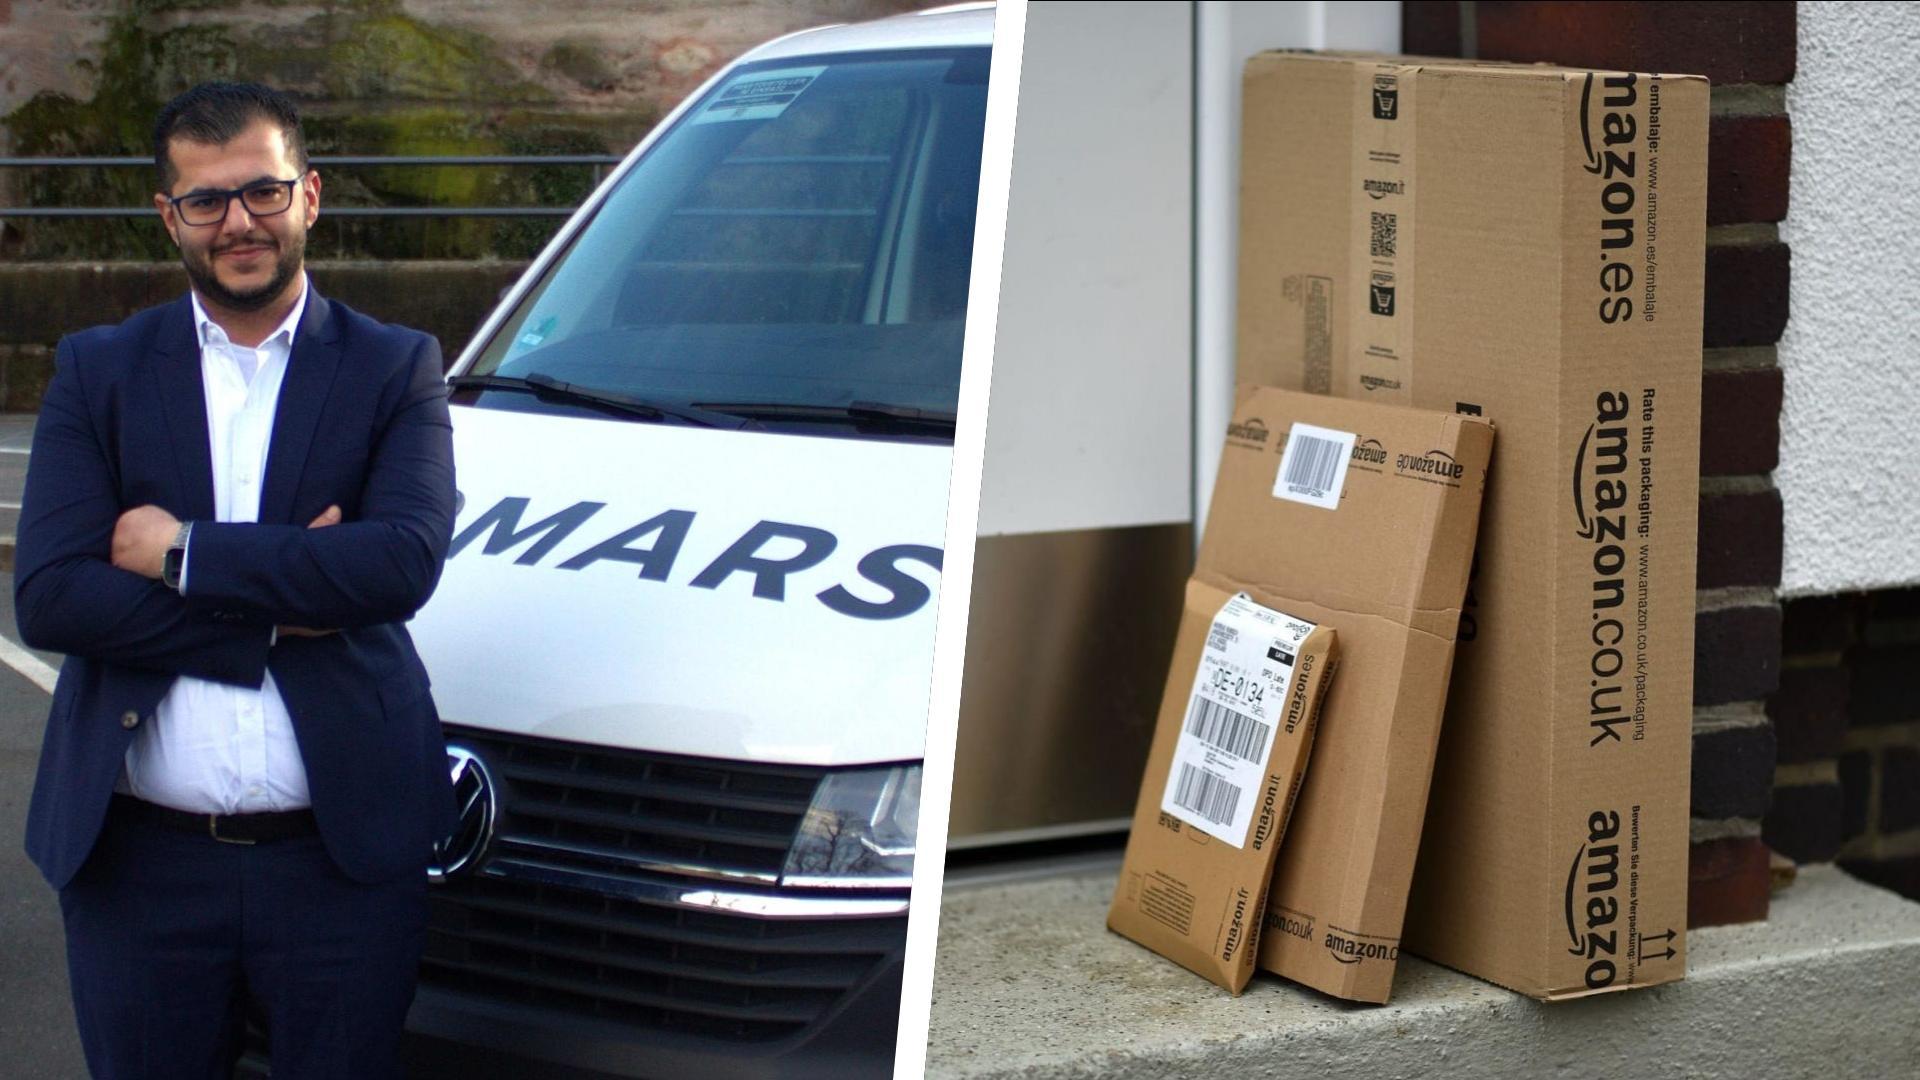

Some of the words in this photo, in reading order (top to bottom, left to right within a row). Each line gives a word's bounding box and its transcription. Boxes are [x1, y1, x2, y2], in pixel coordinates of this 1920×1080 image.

[1647, 84, 1661, 153] embalaje:
[1645, 157, 1658, 322] www.amazon.es/embalaje
[1640, 426, 1655, 454] this
[1642, 388, 1655, 422] Rate
[1397, 452, 1463, 479] amazon.de
[1638, 458, 1653, 538] packaging:
[446, 488, 945, 621] MARS
[1590, 391, 1631, 748] amazon.co.uk
[1633, 545, 1649, 741] www.amazon.co.uk/packaging
[1285, 654, 1315, 734] amazon.es
[1253, 774, 1281, 850] amazon.it
[1631, 805, 1640, 852] Bewerten
[1585, 811, 1620, 989] amazo
[1630, 872, 1639, 899] diese
[1631, 855, 1640, 870] Sie
[1222, 887, 1250, 962] amazon.fr
[1627, 899, 1639, 960] Verpackung:
